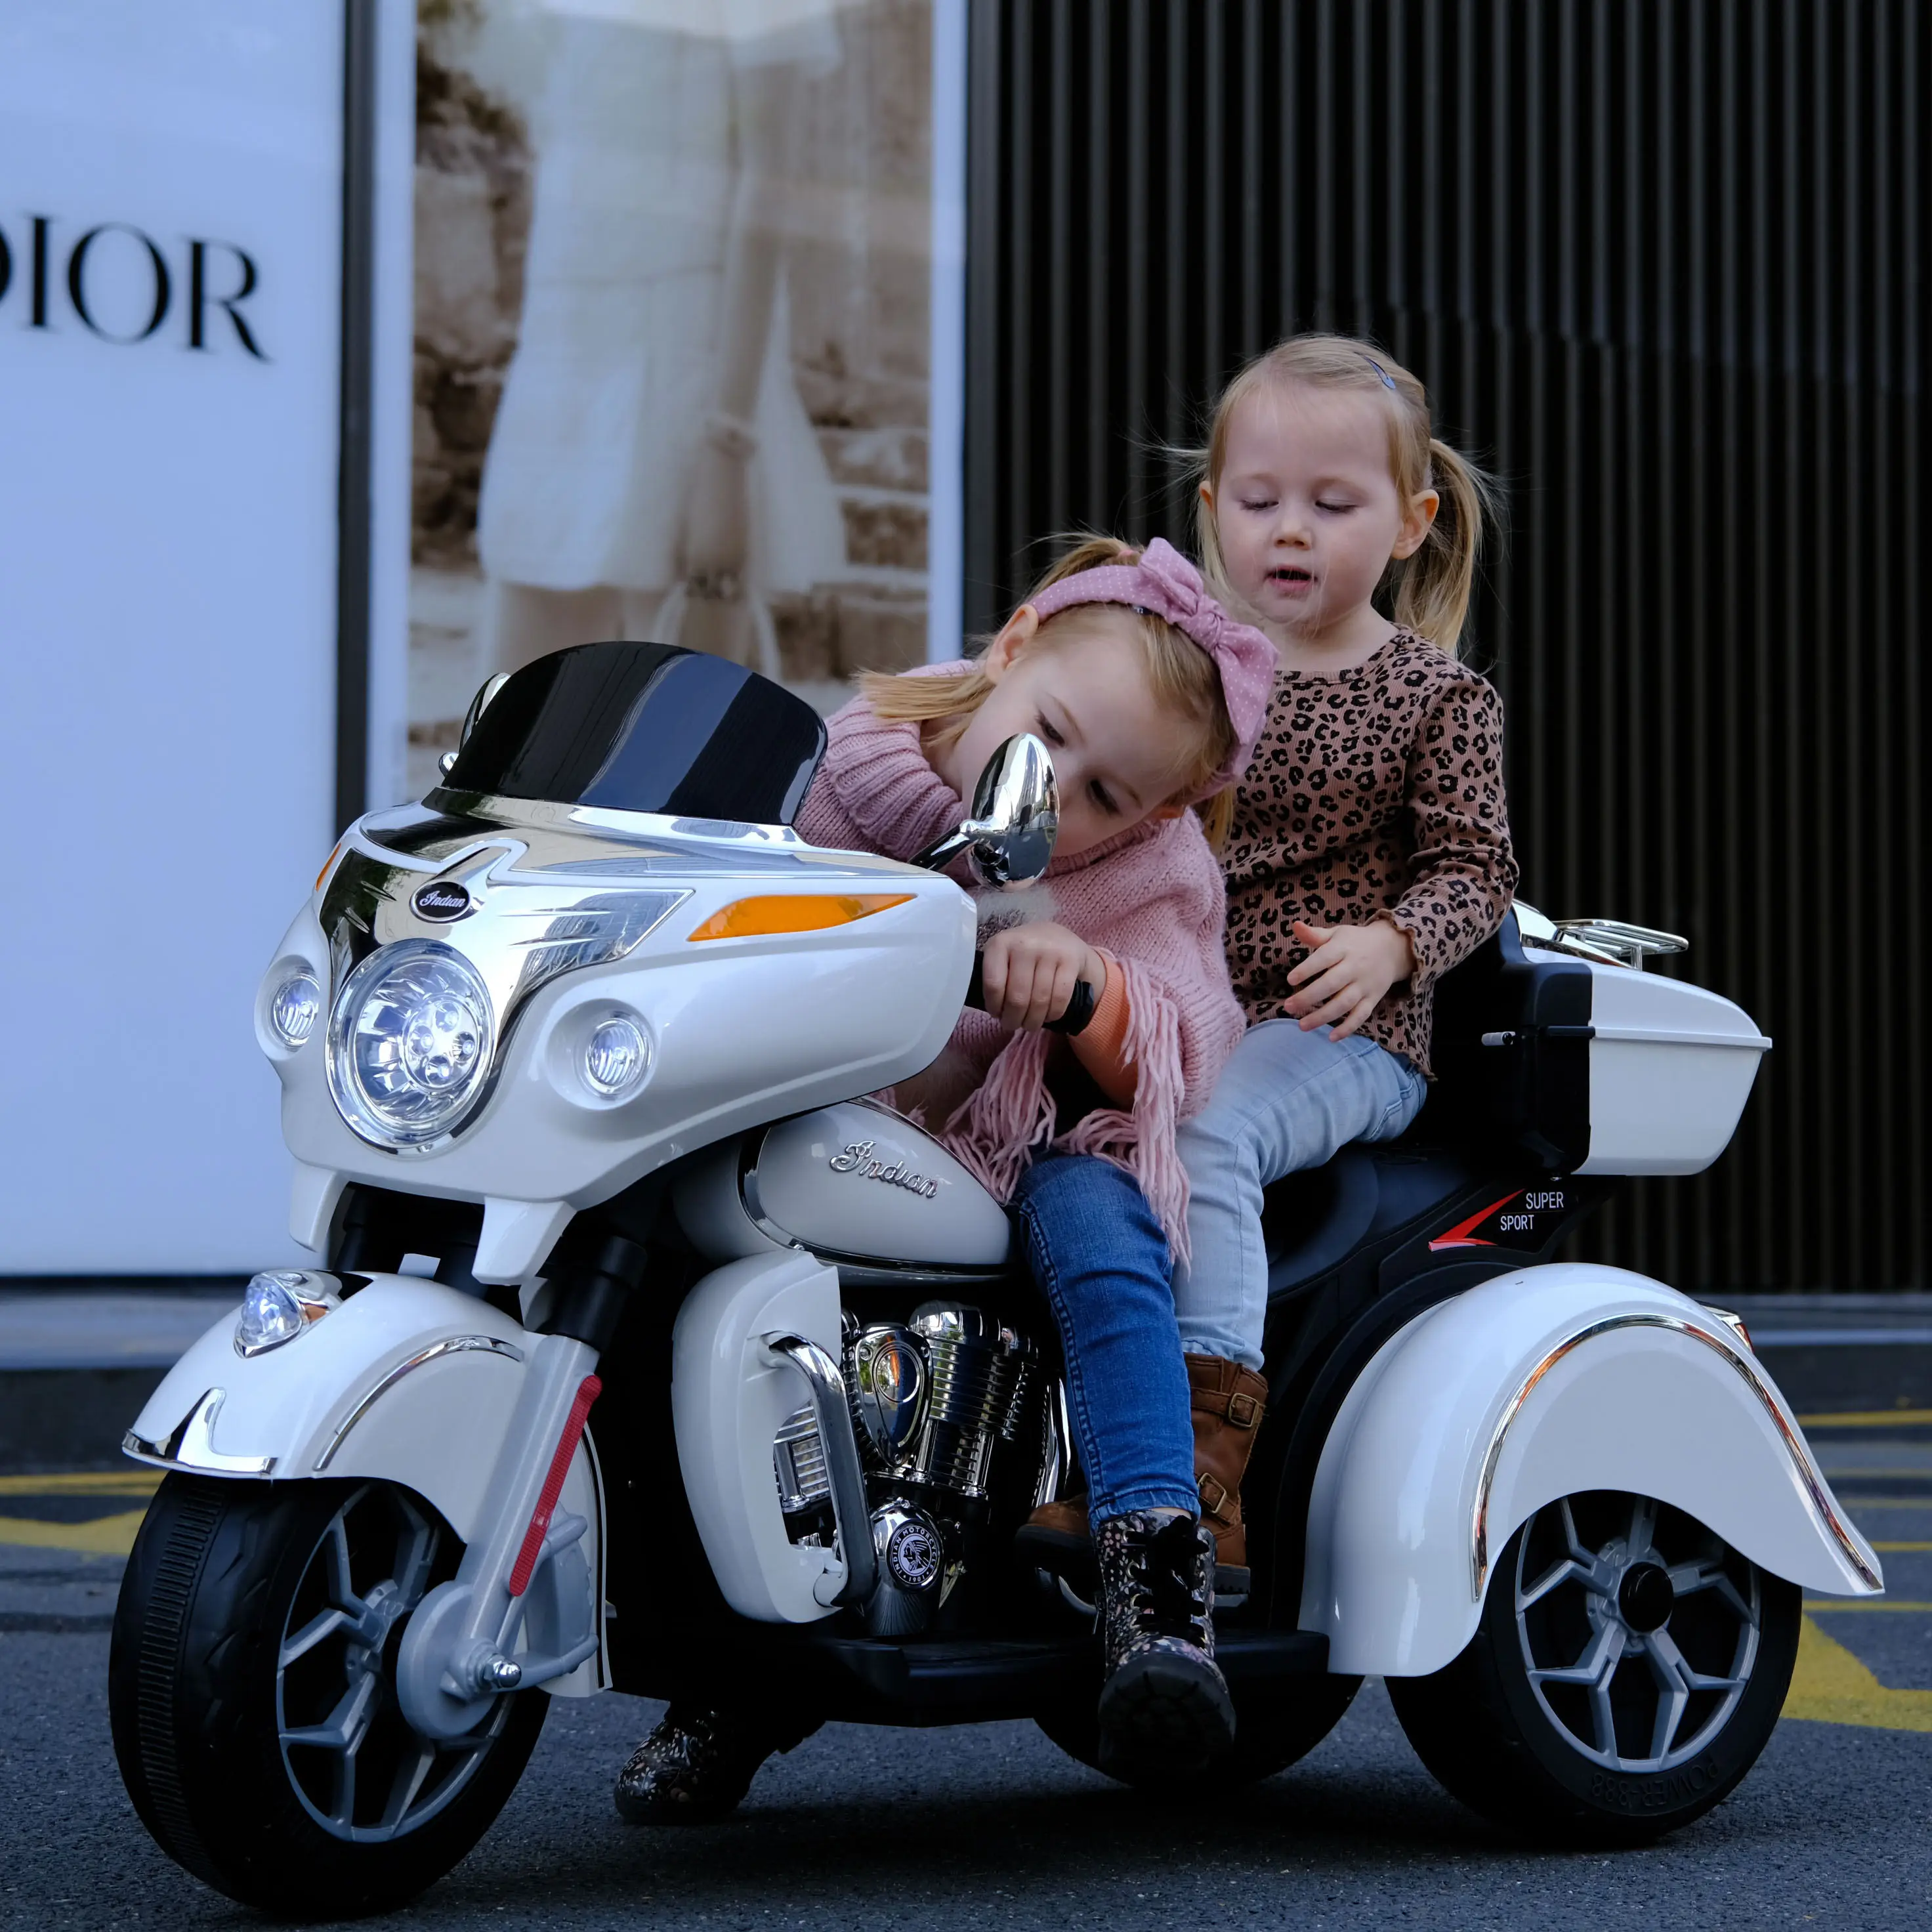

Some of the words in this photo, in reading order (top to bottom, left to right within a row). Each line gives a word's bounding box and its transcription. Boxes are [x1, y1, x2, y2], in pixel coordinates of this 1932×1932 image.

[0, 215, 274, 365] IOR
[419, 890, 466, 908] Indian
[830, 1140, 938, 1198] Indian
[1526, 1191, 1564, 1209] SUPER
[1500, 1214, 1534, 1231] SPORT
[892, 1538, 902, 1575] INDIAN
[902, 1526, 936, 1571] MOTORCYCLE
